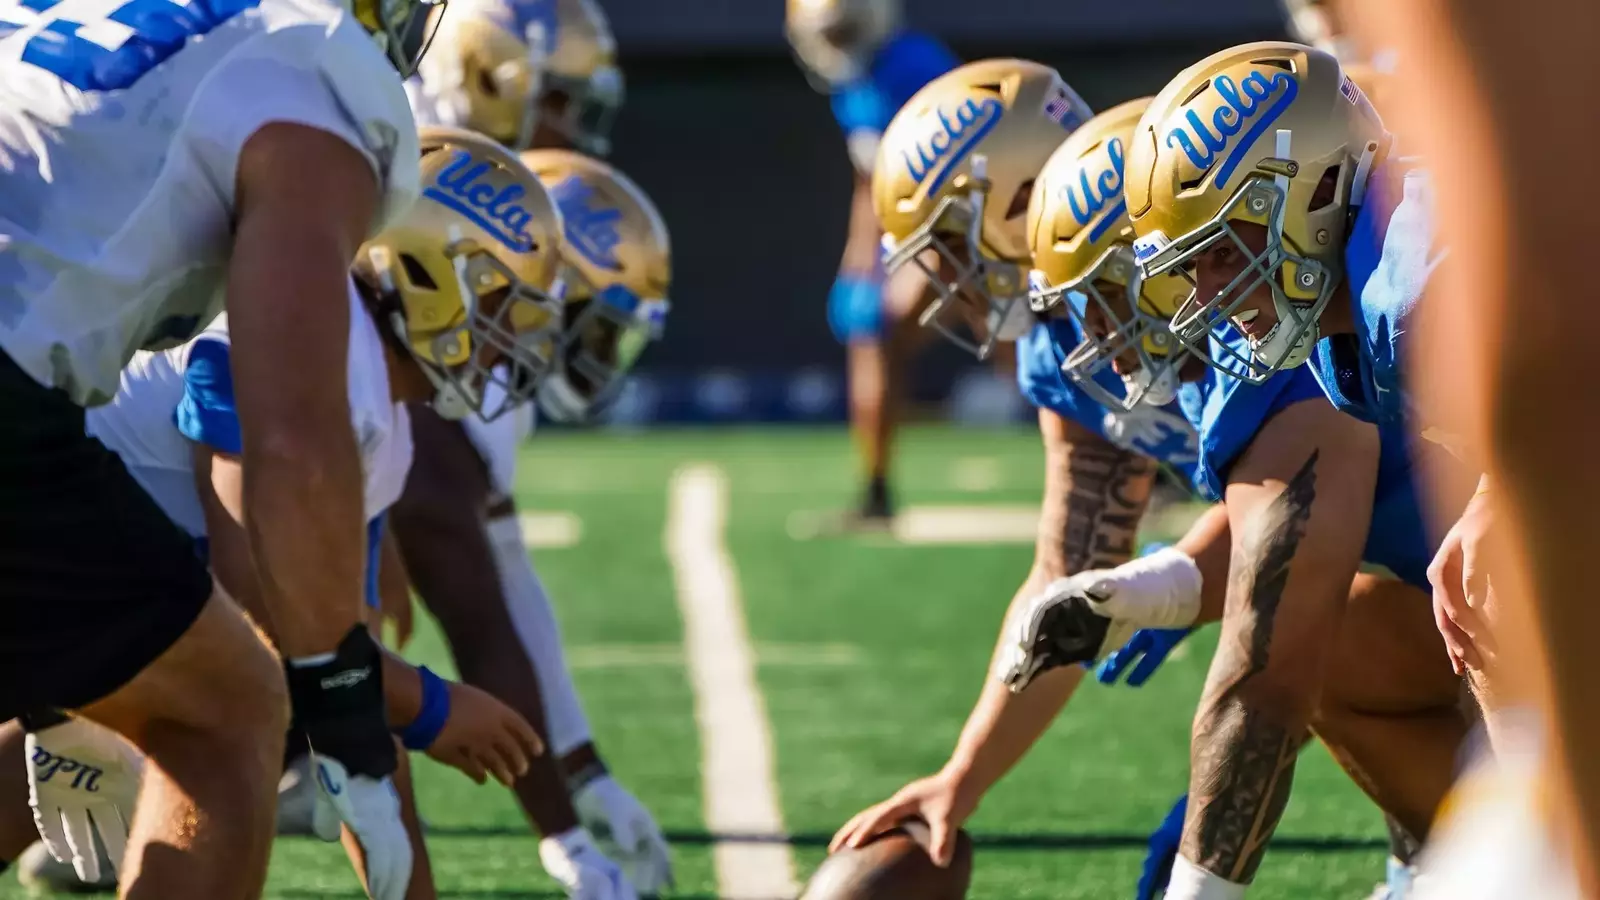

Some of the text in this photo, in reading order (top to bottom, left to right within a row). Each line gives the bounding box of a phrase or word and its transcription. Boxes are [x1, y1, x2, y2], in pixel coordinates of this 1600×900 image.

[900, 96, 1003, 198] Ucla
[1166, 70, 1298, 190] Ucla
[424, 151, 536, 254] Ucla
[1061, 137, 1126, 243] Ucl
[32, 746, 104, 792] Ucla
